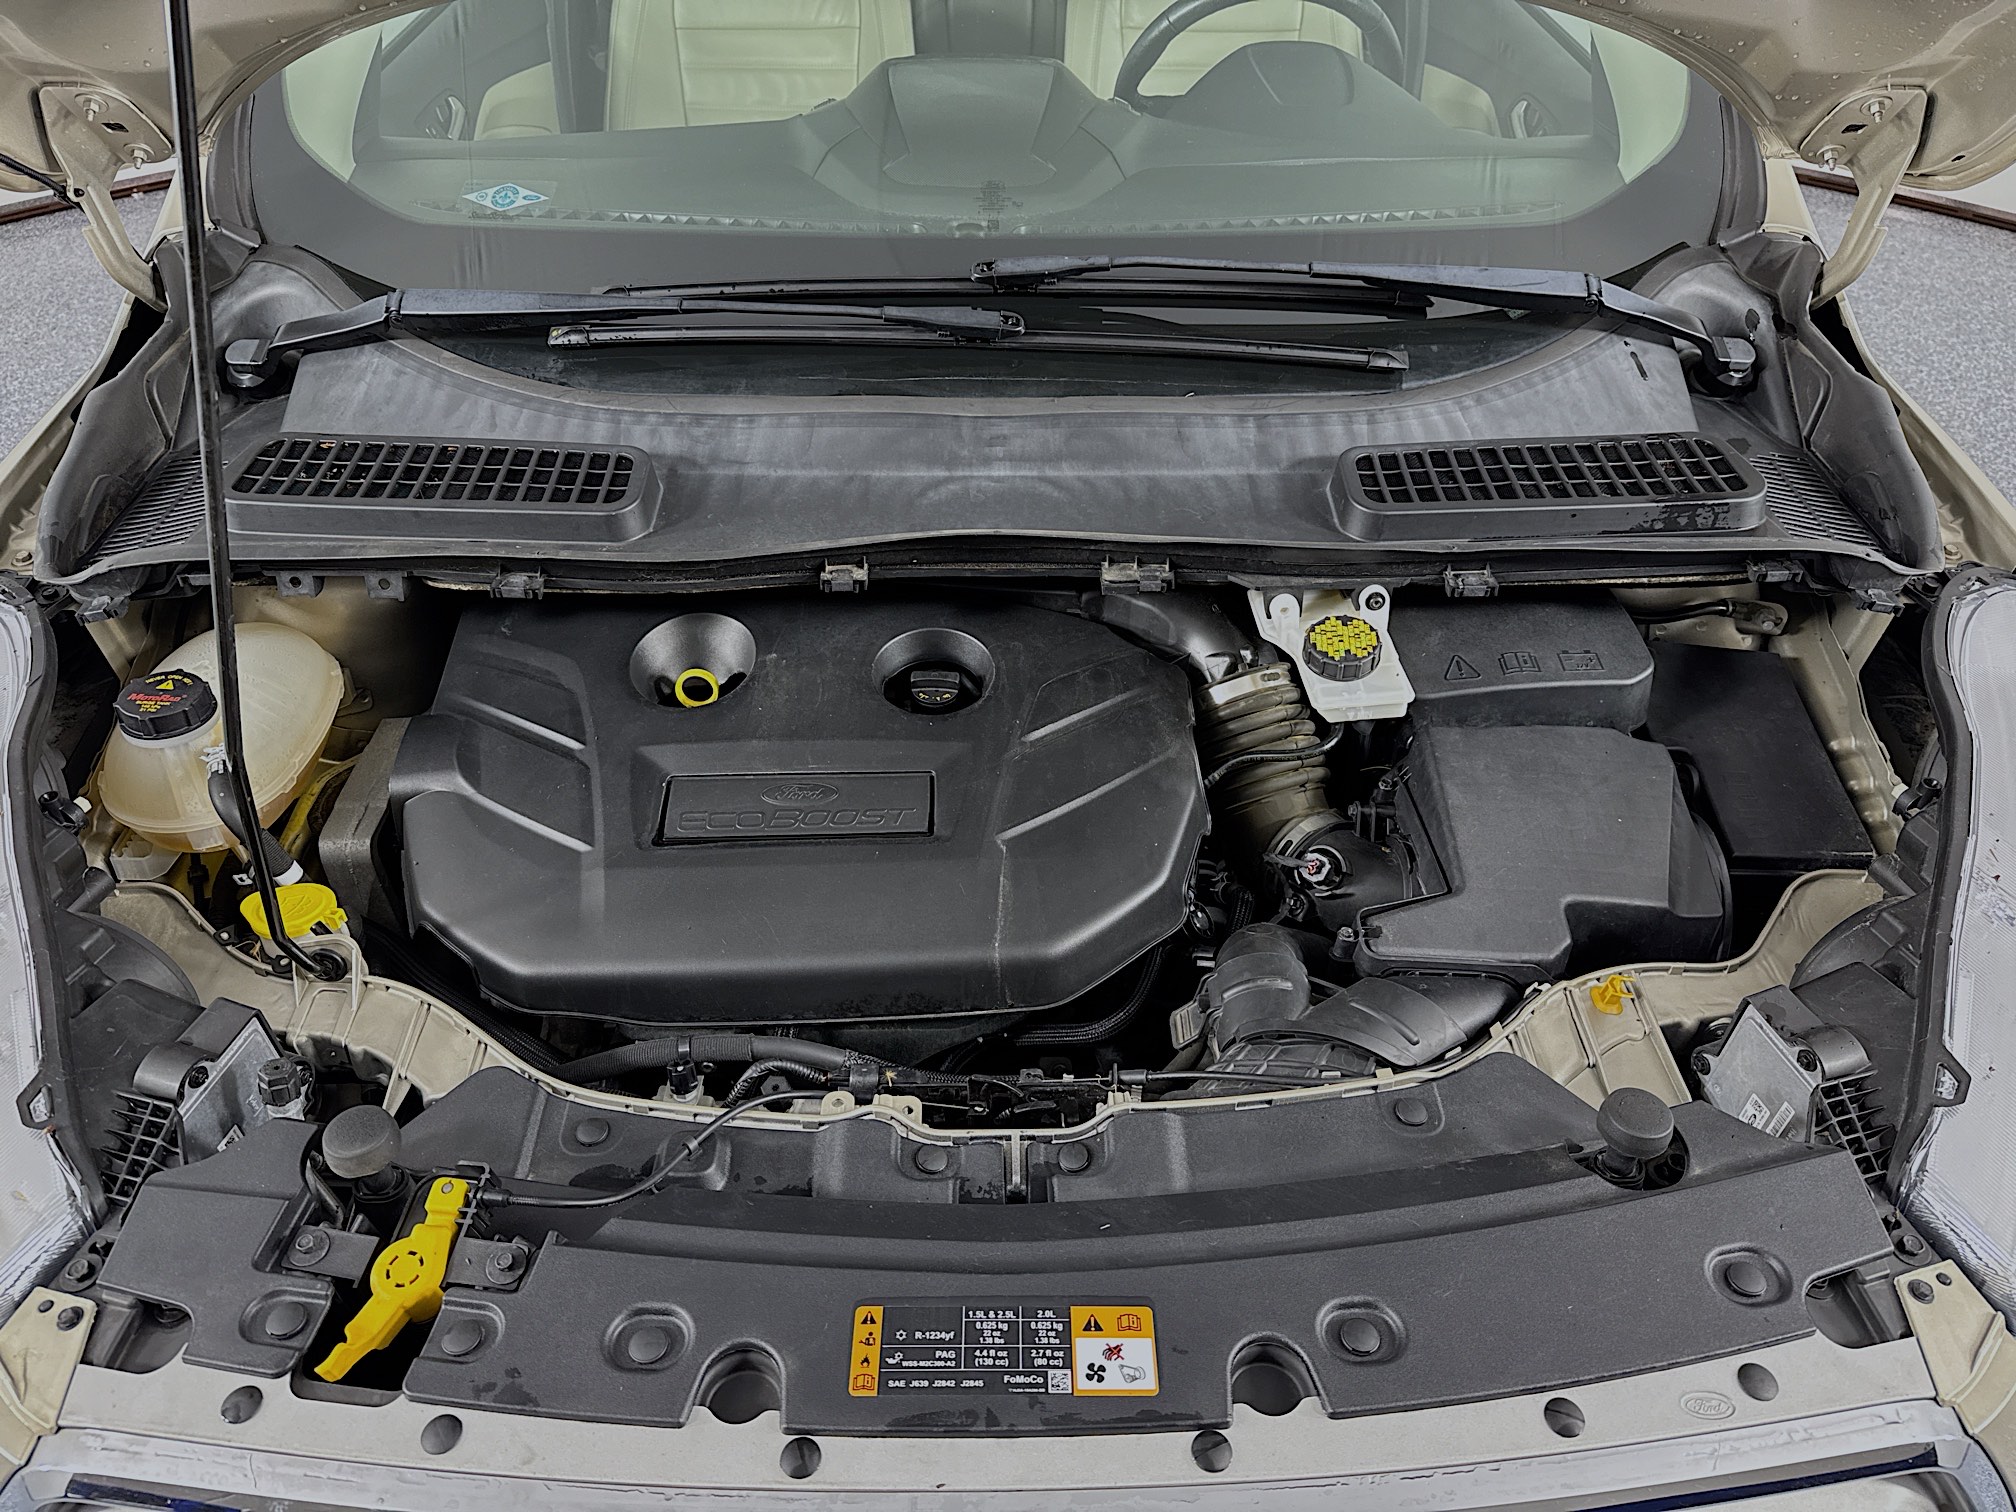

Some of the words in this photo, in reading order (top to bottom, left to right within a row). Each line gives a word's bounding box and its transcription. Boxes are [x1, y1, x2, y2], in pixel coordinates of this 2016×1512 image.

[775, 784, 826, 800] Ford
[968, 1310, 987, 1318] 1.5L
[988, 1310, 996, 1318] &
[997, 1310, 1017, 1318] 2.5L
[1037, 1310, 1056, 1318] 2.0L
[975, 1321, 997, 1330] 0.625
[998, 1321, 1009, 1331] kg
[1030, 1321, 1052, 1330] 0.625
[1052, 1321, 1063, 1331] kg
[914, 1331, 955, 1341] R-1234yf
[935, 1350, 956, 1359] PAG
[974, 1349, 988, 1357] 4.4
[989, 1349, 996, 1357] fl
[1030, 1349, 1044, 1357] 2.7
[1045, 1349, 1052, 1357] fl
[974, 1358, 994, 1367] (130
[994, 1358, 1009, 1367] cc)
[1033, 1358, 1048, 1367] (80
[1048, 1358, 1063, 1367] cc)
[1003, 1375, 1044, 1384] FoMoCo
[1694, 1399, 1722, 1412] Ford
